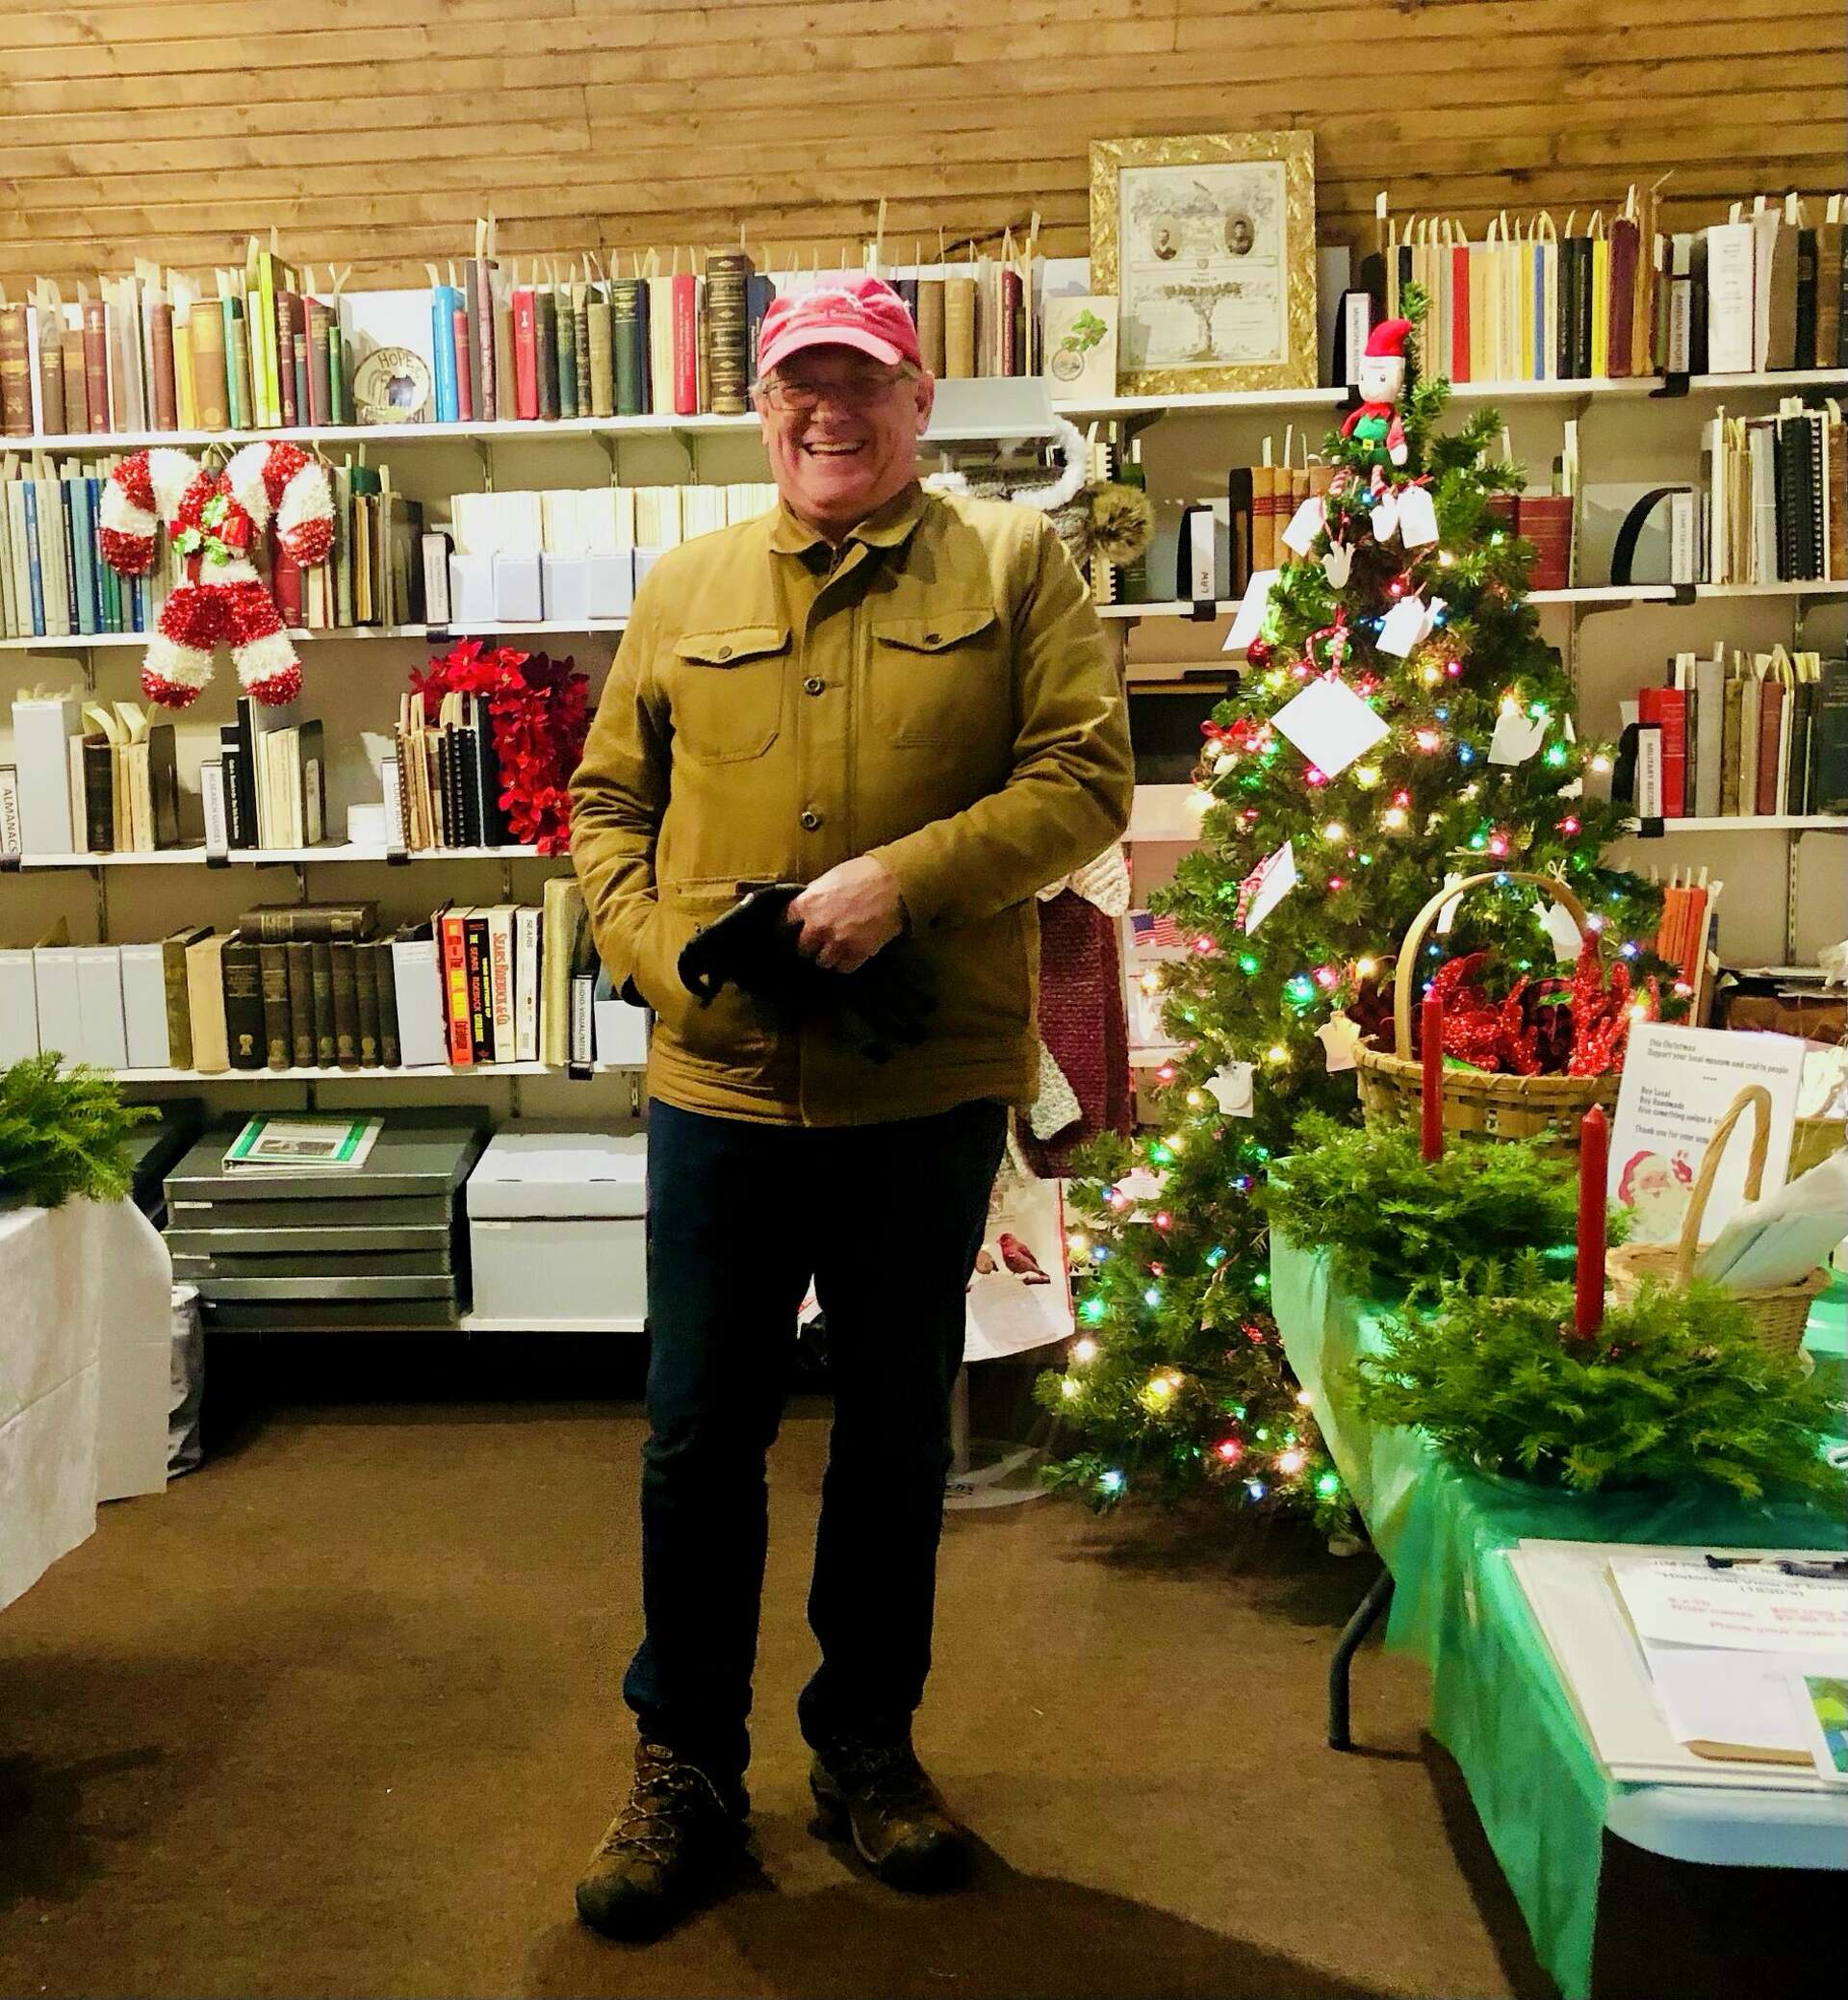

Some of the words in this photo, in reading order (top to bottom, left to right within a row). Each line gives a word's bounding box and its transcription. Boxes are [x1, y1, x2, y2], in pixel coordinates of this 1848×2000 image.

[377, 352, 413, 369] HOPE
[1200, 571, 1210, 593] LAW
[3, 788, 18, 854] ALMANACS
[213, 815, 222, 844] GUIDES
[525, 918, 534, 948] SEARS
